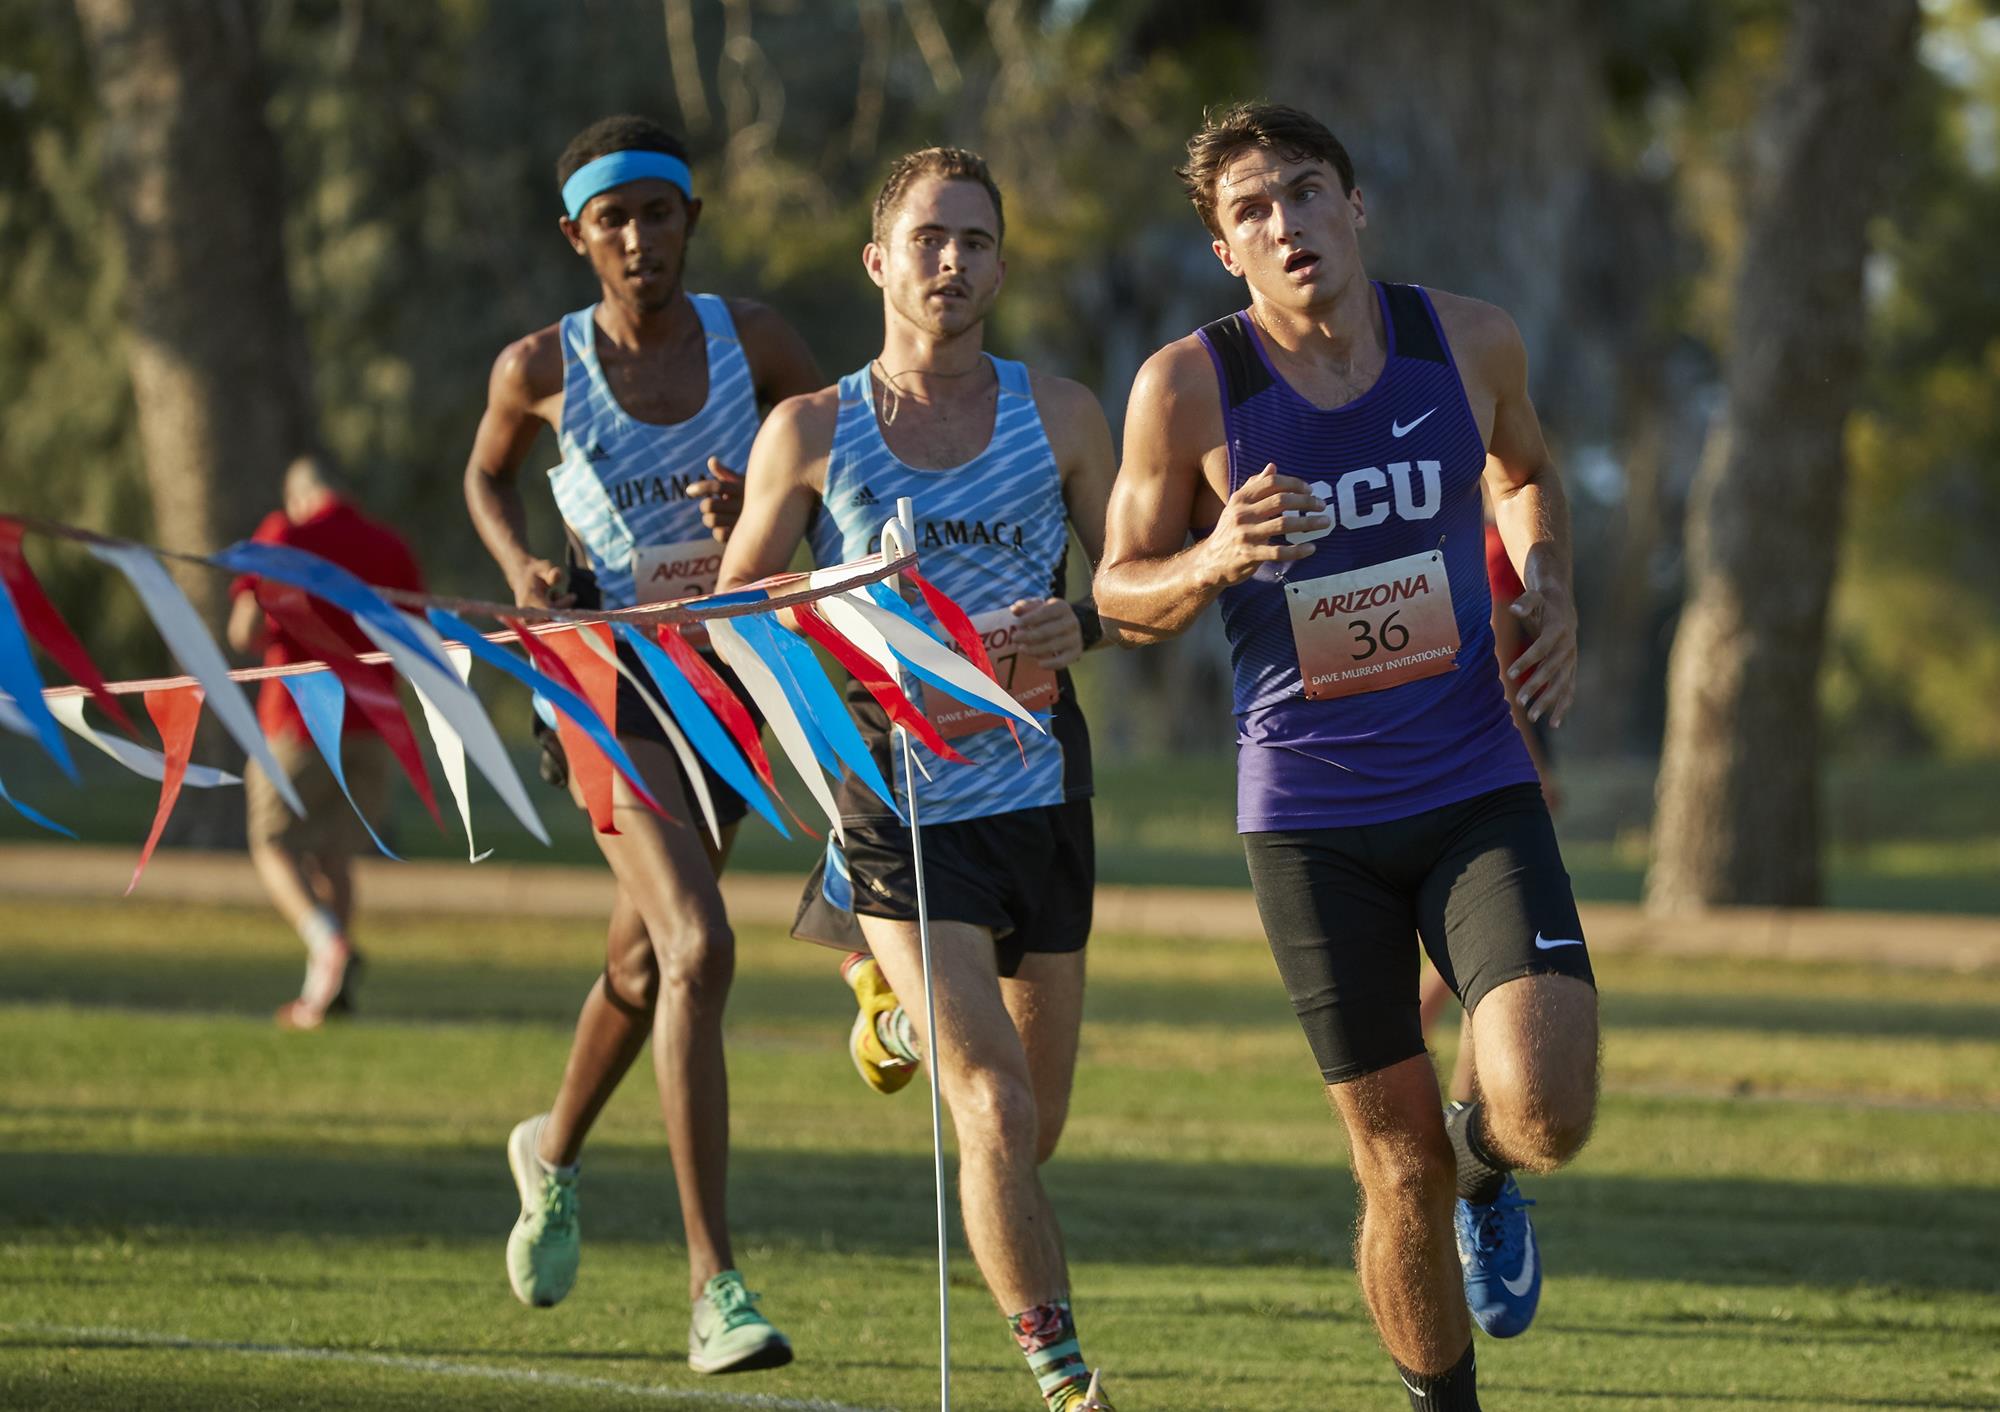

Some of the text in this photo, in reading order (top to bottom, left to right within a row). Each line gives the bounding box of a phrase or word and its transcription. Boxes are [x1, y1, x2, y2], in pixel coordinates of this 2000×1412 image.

[606, 473, 707, 511] UYAM
[651, 554, 720, 582] ARIZO
[1309, 574, 1429, 620] ARIZONA
[1348, 610, 1410, 660] 36
[997, 652, 1018, 690] 7
[1312, 645, 1455, 686] DAVE MURRAY INVITATIONAL
